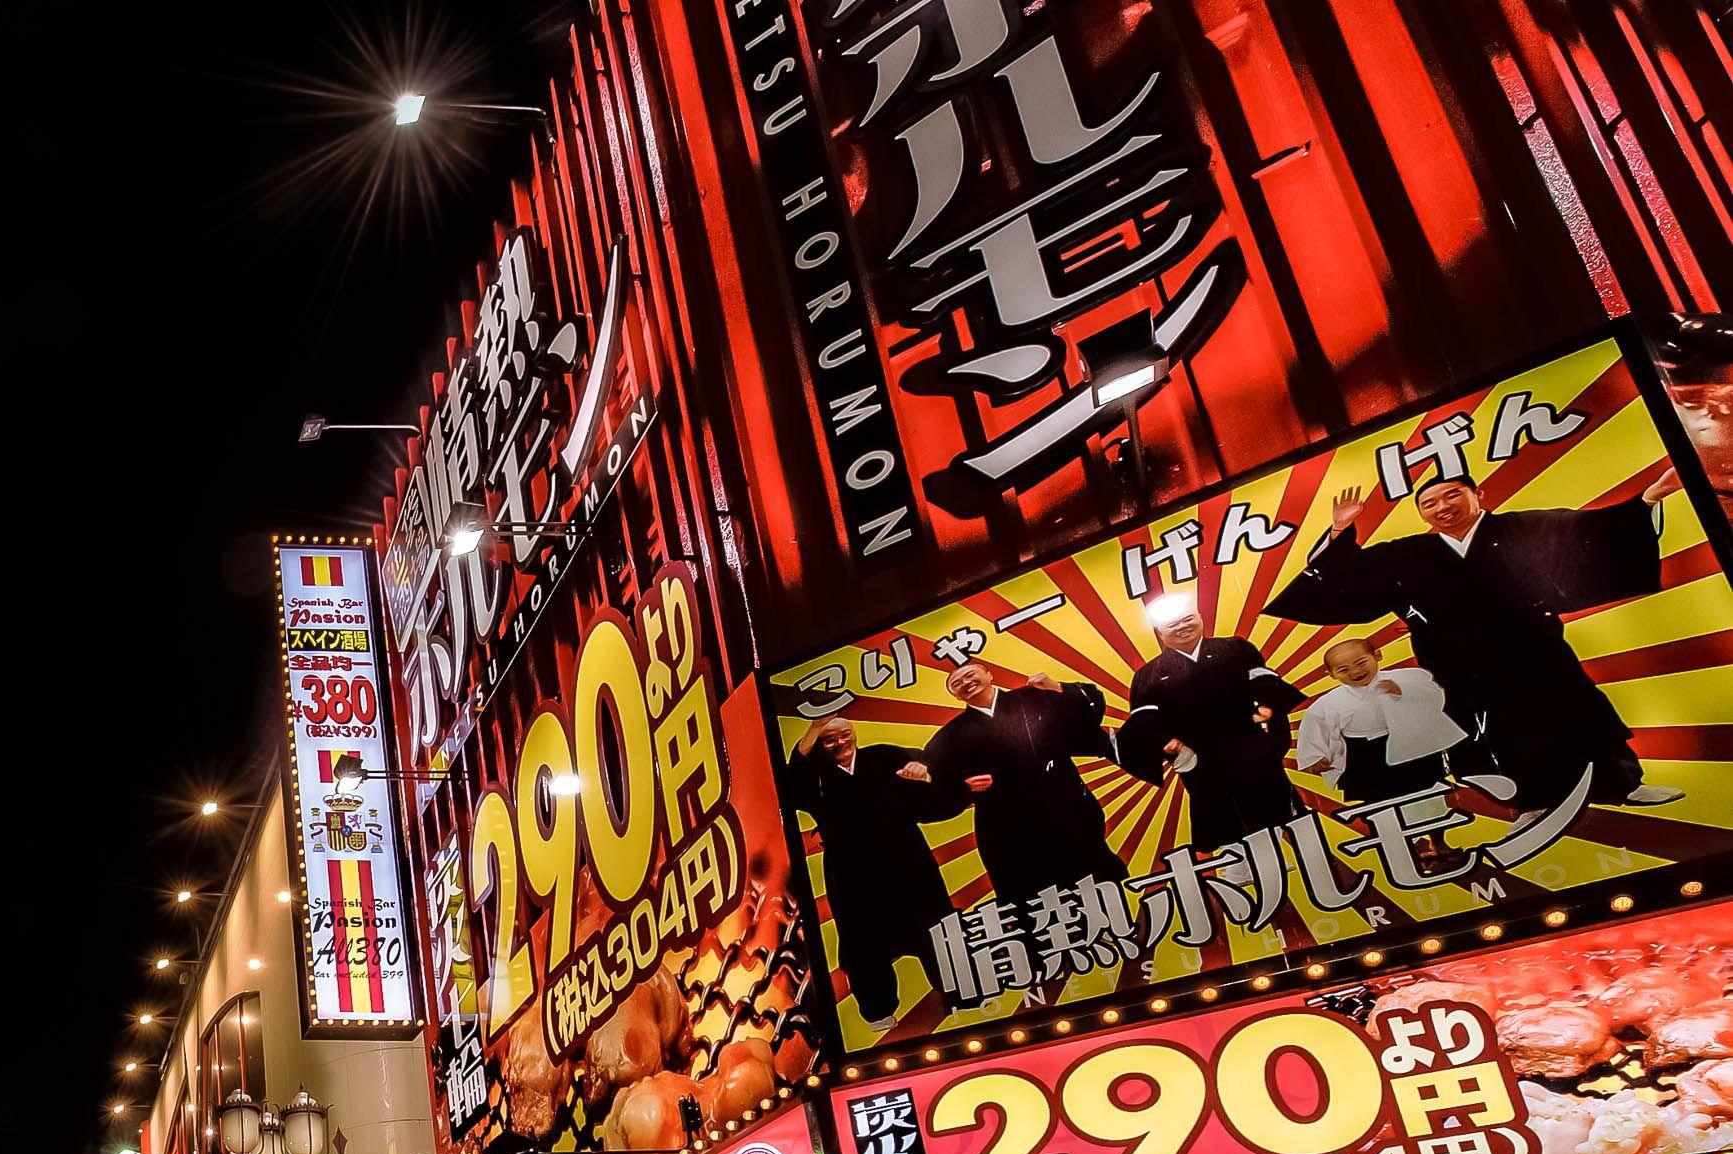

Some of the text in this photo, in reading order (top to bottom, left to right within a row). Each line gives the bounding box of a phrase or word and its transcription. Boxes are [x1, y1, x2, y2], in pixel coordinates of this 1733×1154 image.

[781, 177, 912, 557] HORUMON
[1378, 393, 1587, 502] げん
[402, 234, 620, 768] ホルモン
[512, 396, 650, 645] HORUMON
[1124, 503, 1296, 599] げん
[287, 598, 364, 609] Spanish Bar
[289, 609, 366, 627] Pasion
[290, 630, 367, 650] スペイン酒場
[293, 674, 377, 725] ¥380
[796, 593, 1064, 718] こりゃー
[470, 576, 721, 1039] 290 円 より
[309, 897, 396, 911] Spanish Bar
[312, 911, 397, 933] Pasion
[931, 760, 1595, 1001] 情熱ホルモン
[546, 816, 739, 1054] (税込304円)
[950, 845, 1635, 1027] JONETSU HORUMON
[1381, 1006, 1485, 1076] より
[1388, 1061, 1513, 1138] 円
